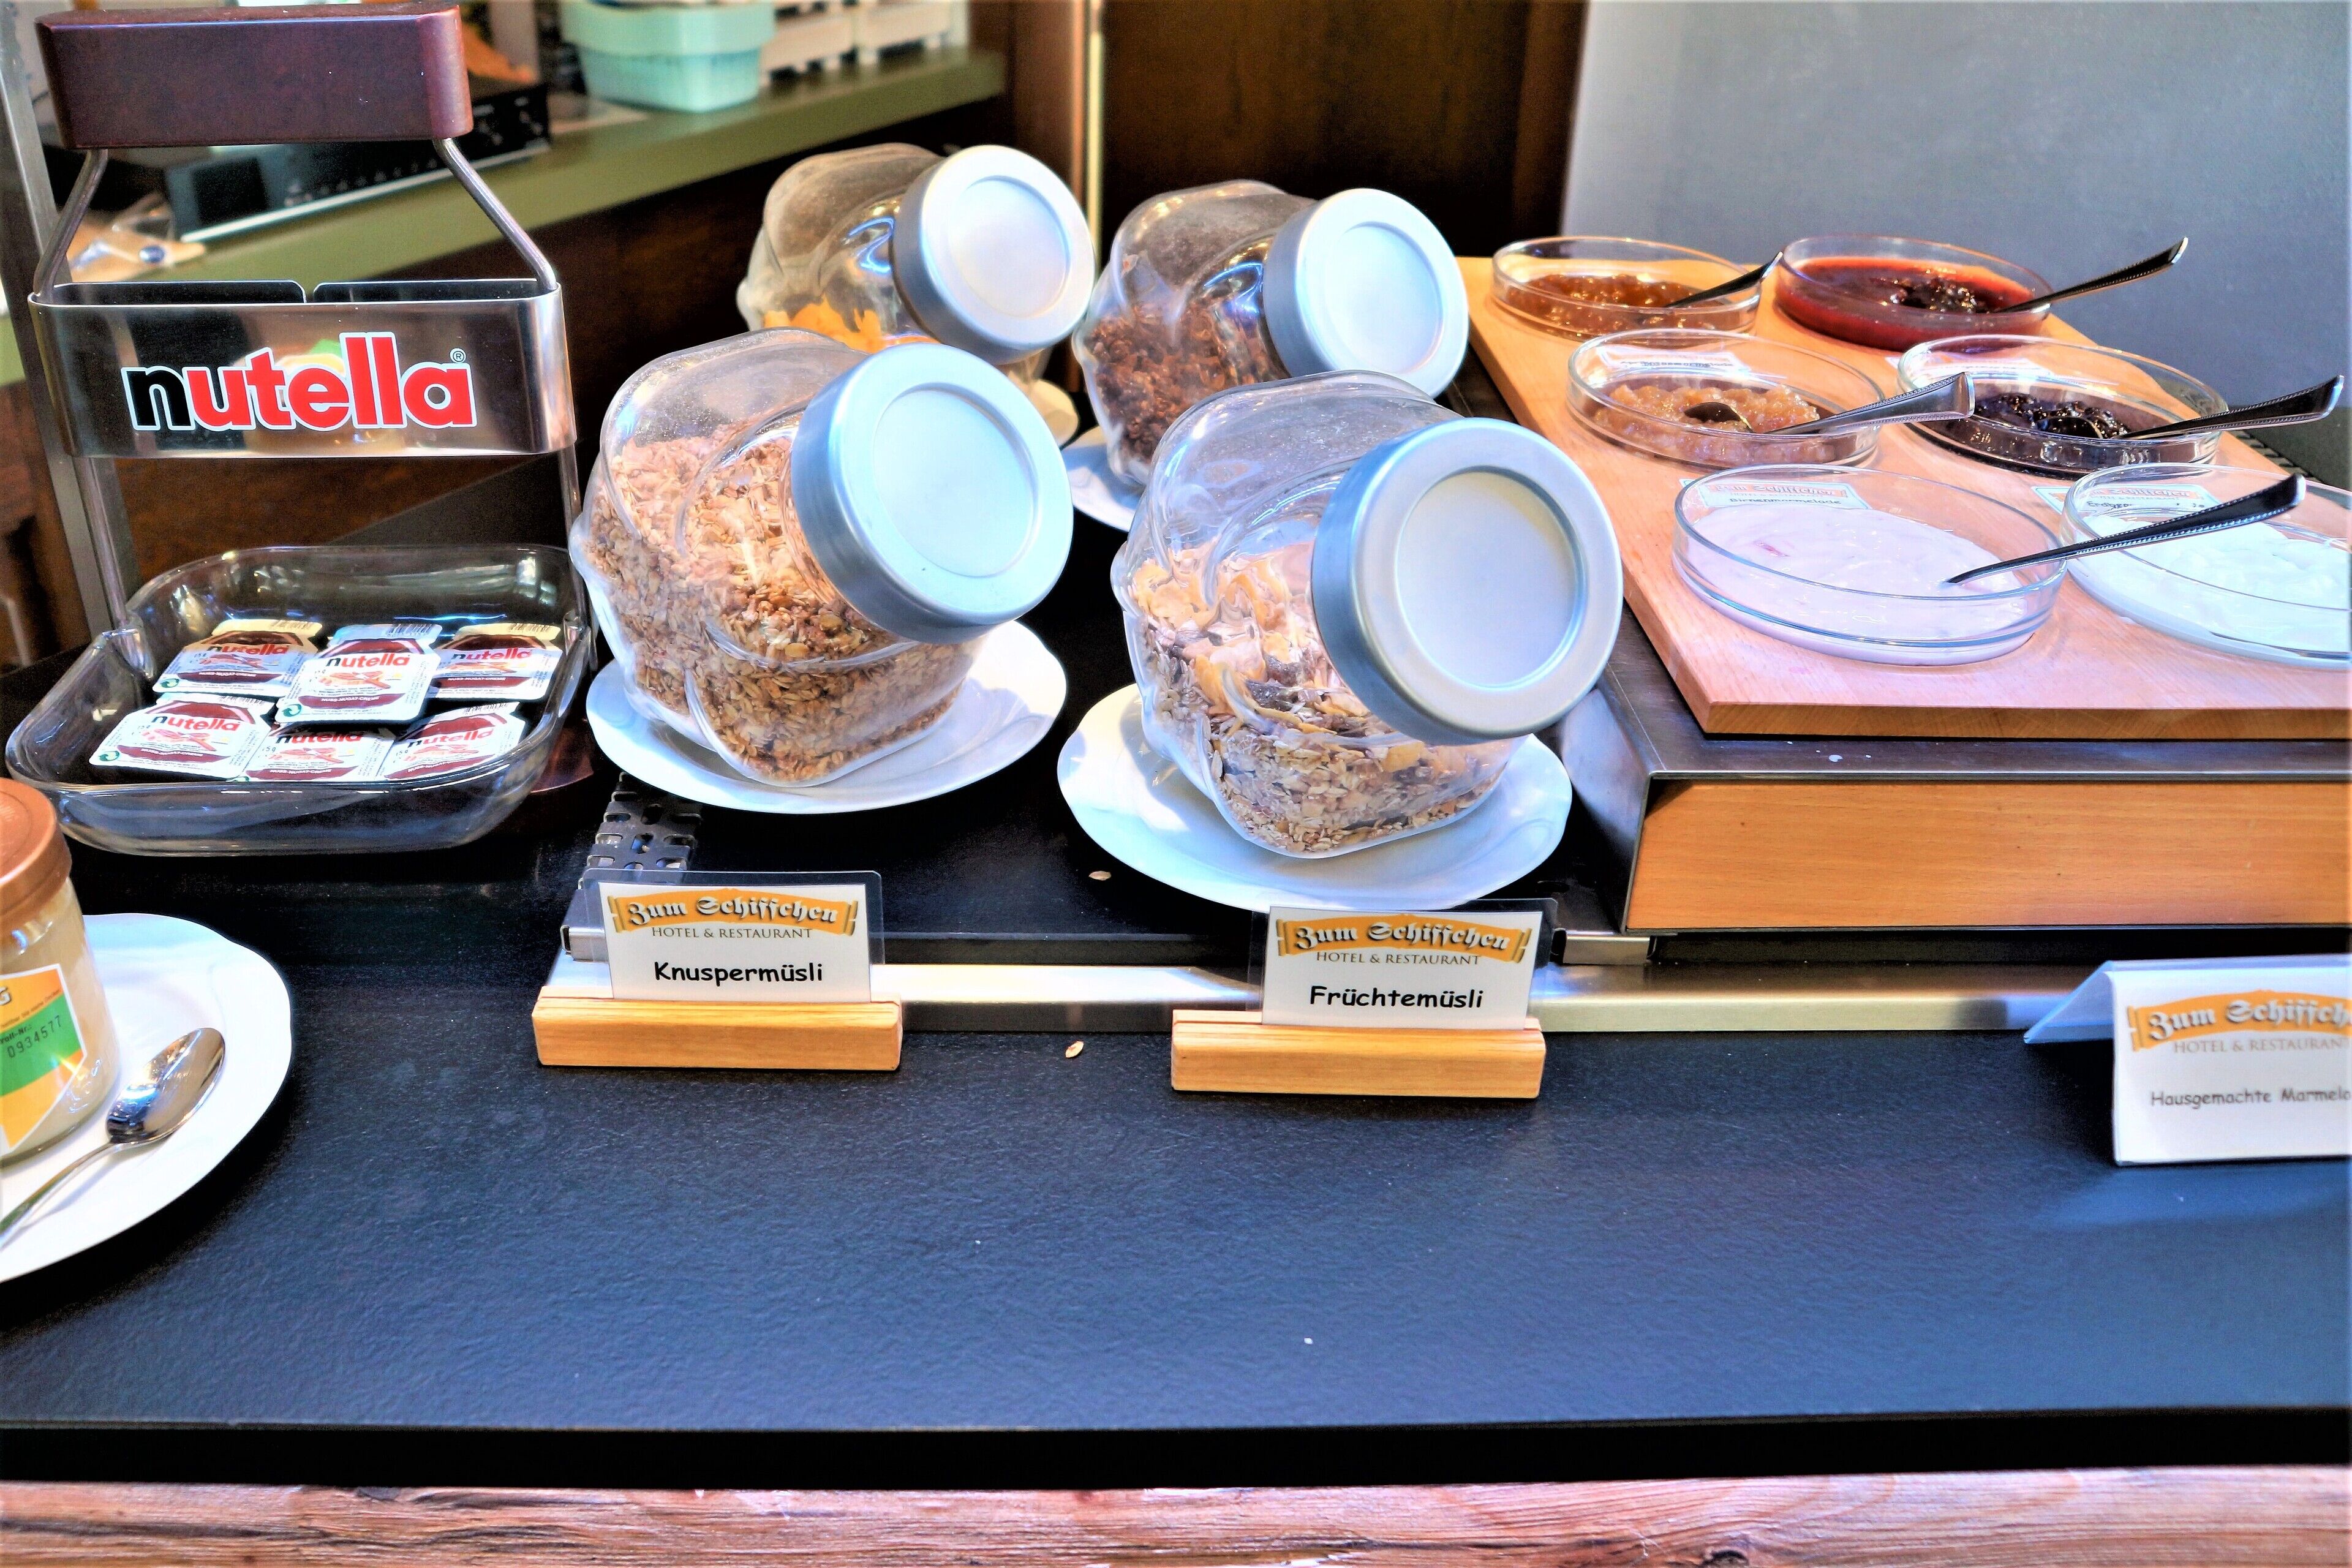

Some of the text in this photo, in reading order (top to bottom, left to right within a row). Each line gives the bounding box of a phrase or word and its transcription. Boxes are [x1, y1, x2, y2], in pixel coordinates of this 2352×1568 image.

[123, 333, 477, 429] nutella
[207, 644, 290, 656] nutella
[451, 647, 532, 661] nutella
[326, 653, 410, 668] nutella
[151, 715, 241, 731] nutella
[407, 728, 495, 748] nutella
[628, 896, 839, 925] Zum Schiffchen
[652, 927, 813, 938] HOTEL & RESTAURANT
[1295, 922, 1511, 951] Zum Schiffchen
[1316, 951, 1482, 965] HOTEL & RESTAURANT
[654, 961, 823, 987] Knuspermüsli
[1310, 985, 1483, 1008] Früchtemüsli
[2149, 998, 2352, 1040] Zum Schiffch
[7, 1015, 62, 1058] 0934577
[2174, 1041, 2225, 1054] HOTEL
[2233, 1041, 2244, 1052] &
[2151, 1088, 2271, 1109] Hausgemachte
